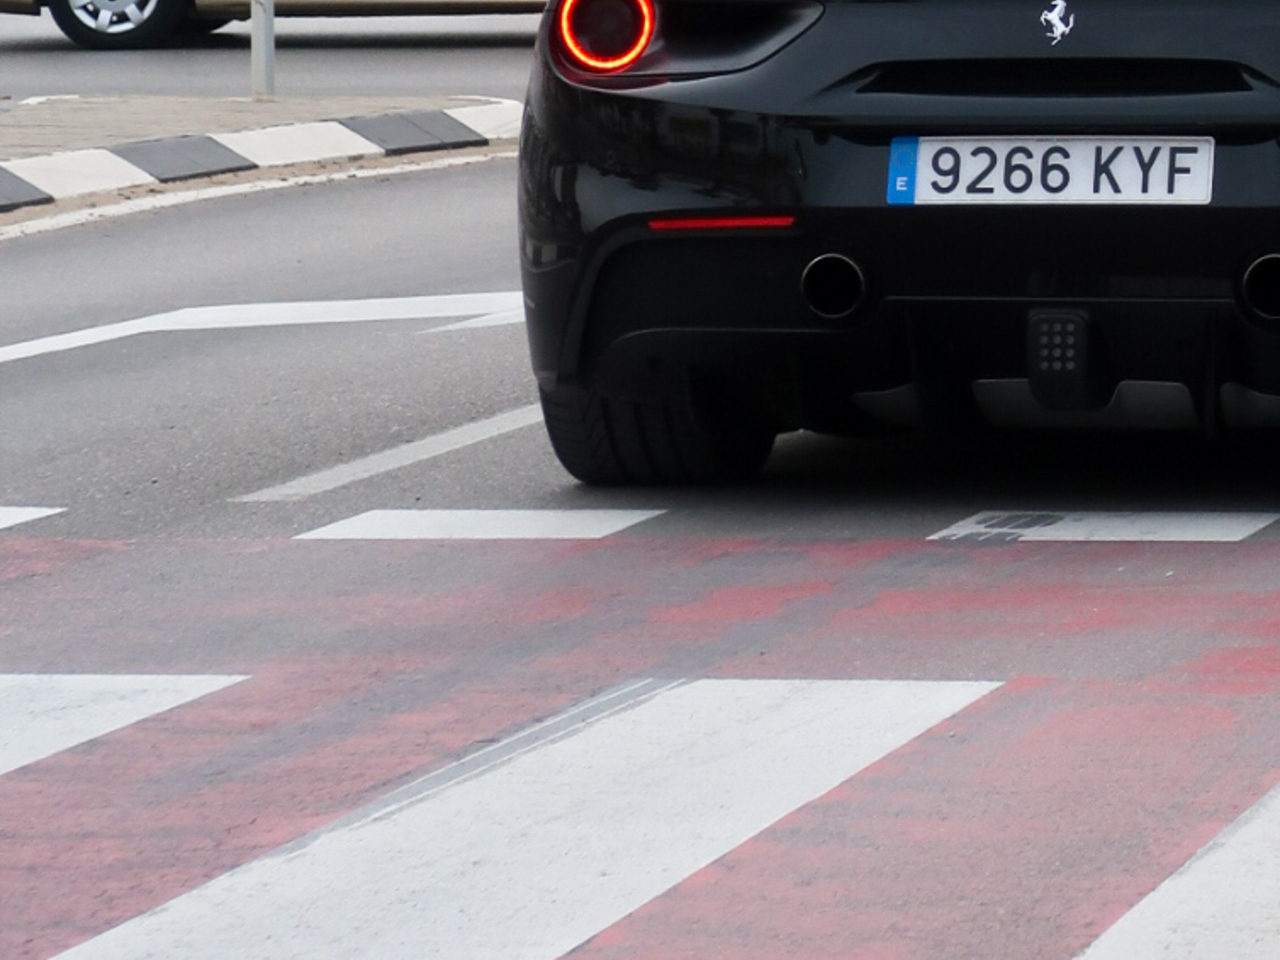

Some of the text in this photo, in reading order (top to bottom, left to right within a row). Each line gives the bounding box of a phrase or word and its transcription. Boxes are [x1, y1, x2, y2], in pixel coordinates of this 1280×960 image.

[896, 177, 908, 191] E
[930, 146, 1199, 194] 9266 KYF
